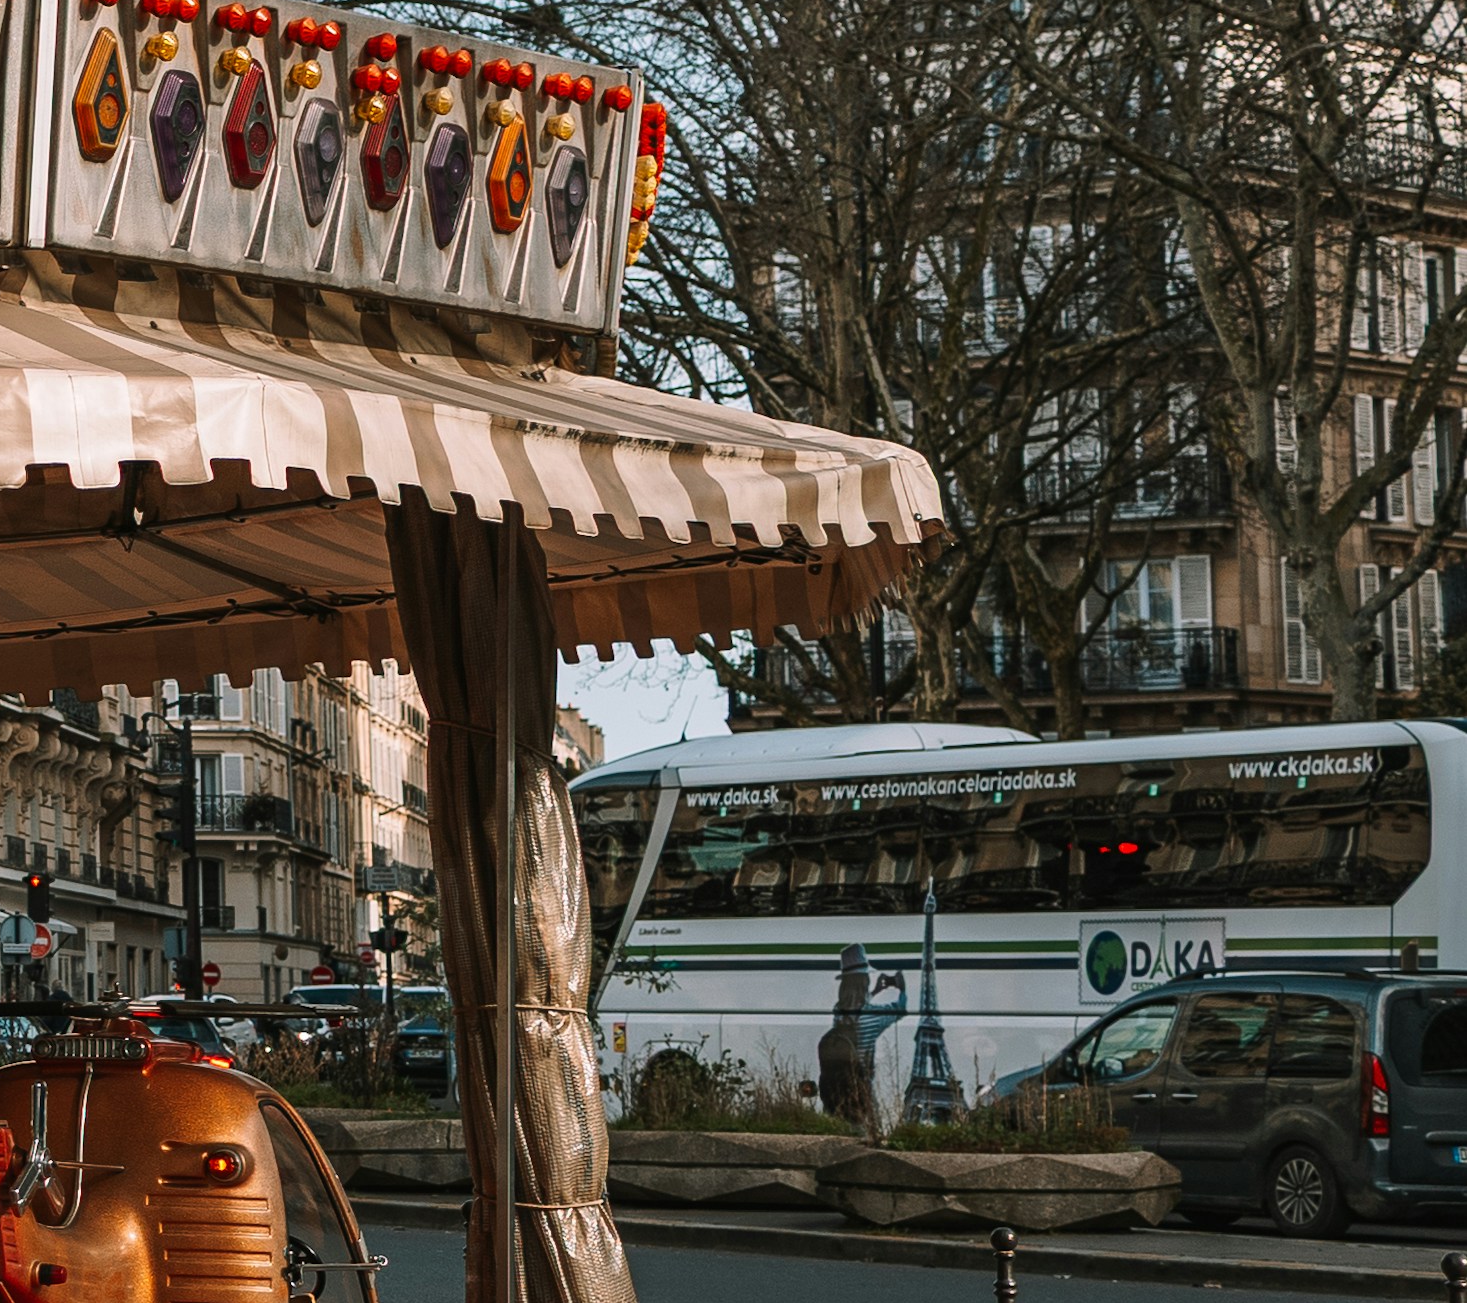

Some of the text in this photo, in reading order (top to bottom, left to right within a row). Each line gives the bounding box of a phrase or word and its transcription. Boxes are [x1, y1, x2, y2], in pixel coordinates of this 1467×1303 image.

[1229, 752, 1374, 779] www.ckdaka.sk
[686, 785, 780, 807] www.daka.sk
[821, 768, 1077, 800] www.cestovnakancelariadaka.sk
